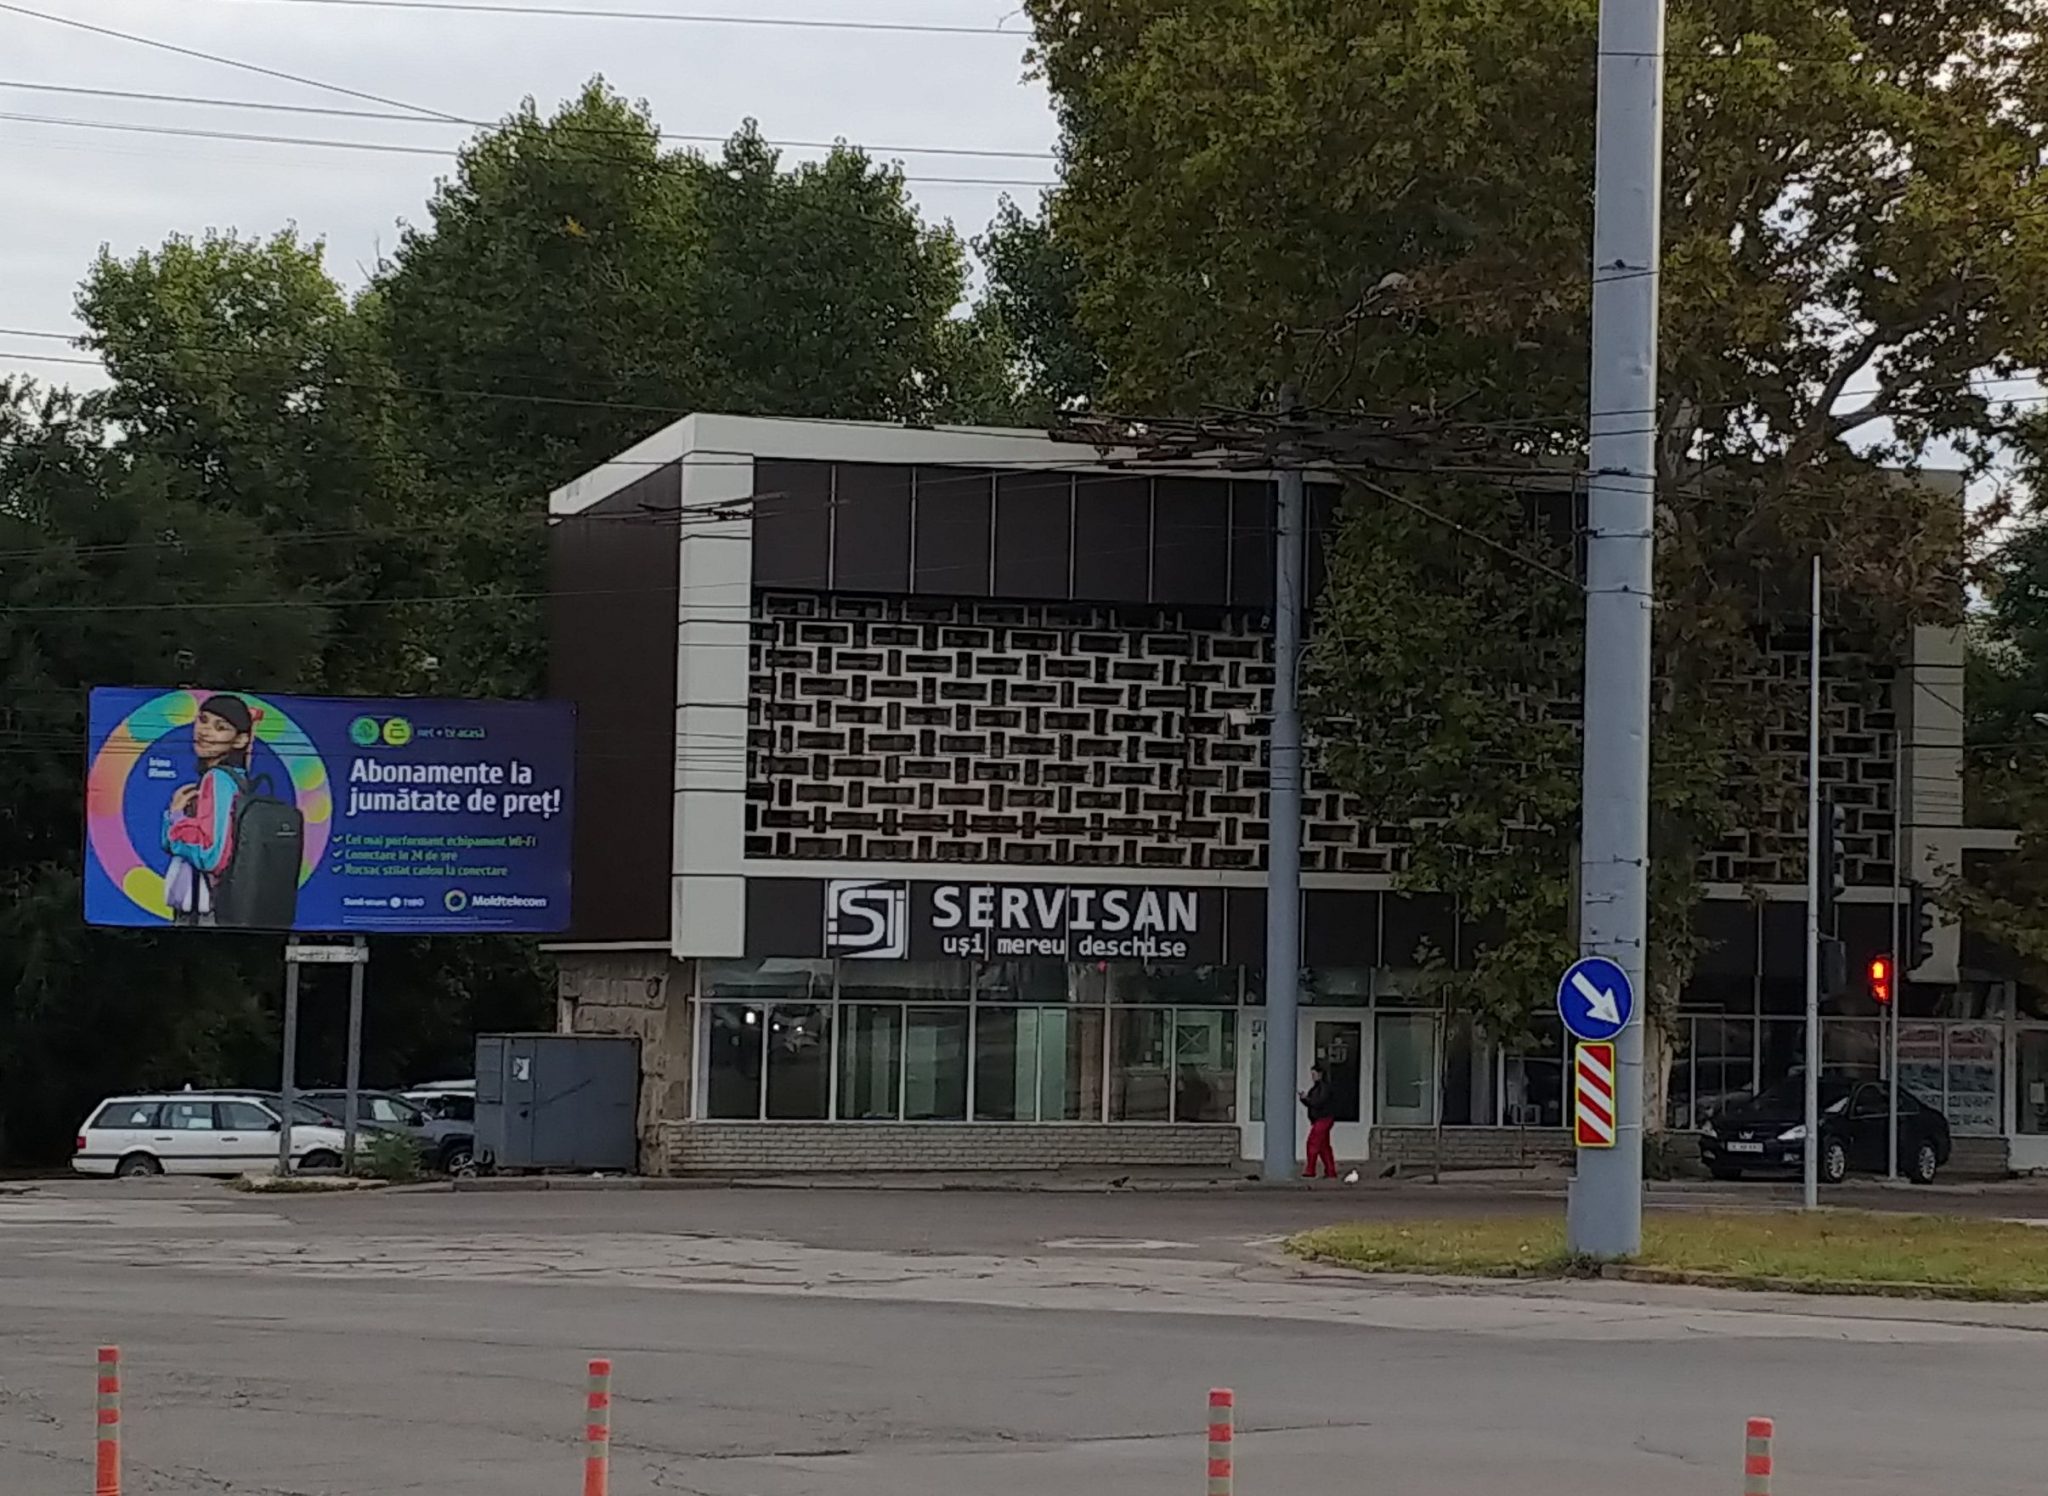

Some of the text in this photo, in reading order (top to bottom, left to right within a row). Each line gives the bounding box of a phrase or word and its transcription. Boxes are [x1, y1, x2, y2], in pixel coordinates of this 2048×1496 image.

[349, 758, 532, 785] Abonamente la
[346, 787, 561, 818] jumătate de preț!
[363, 835, 383, 846] mai
[385, 835, 444, 848] performant
[447, 836, 507, 849] echipament
[472, 895, 547, 907] Moldtelecom
[931, 885, 1199, 932] SERVISAN
[943, 934, 1188, 959] uși mereu deschise
